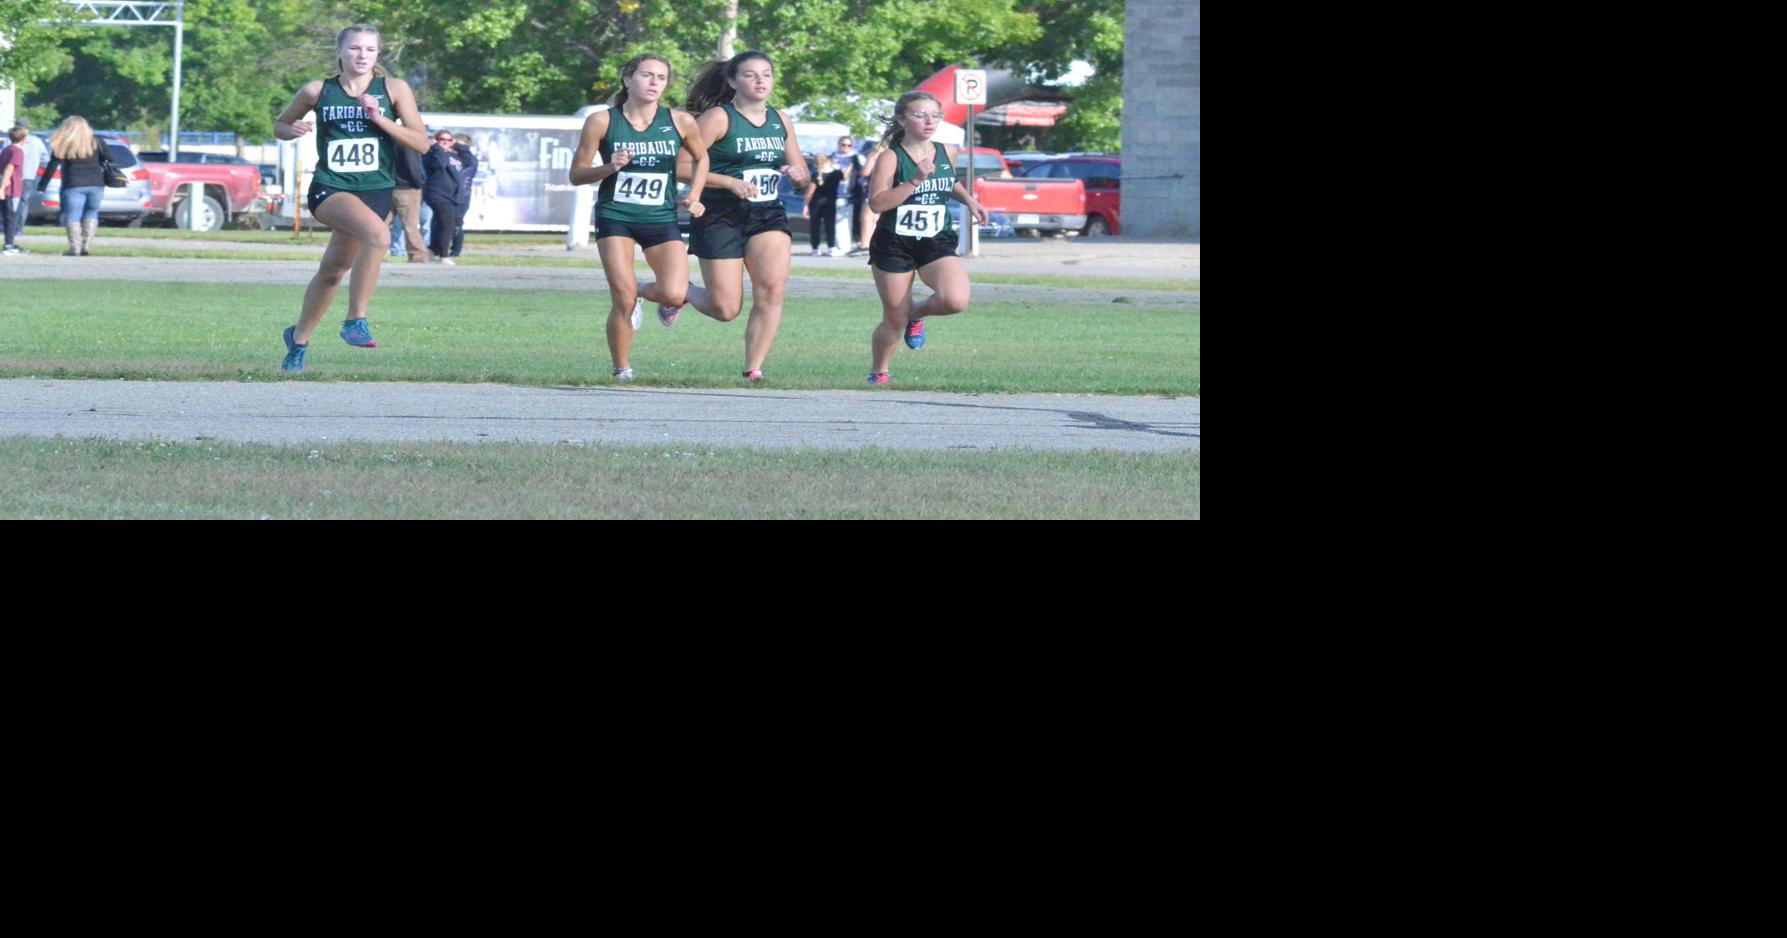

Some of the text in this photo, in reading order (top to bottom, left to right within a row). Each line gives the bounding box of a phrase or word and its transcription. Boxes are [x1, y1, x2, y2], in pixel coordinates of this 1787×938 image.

[322, 105, 386, 122] FARIBAT
[331, 143, 375, 167] 448
[539, 137, 577, 169] Fin
[736, 137, 785, 153] FARIBAUL
[618, 177, 663, 199] 449
[912, 177, 955, 194] RIBAULT
[899, 210, 940, 231] 451
